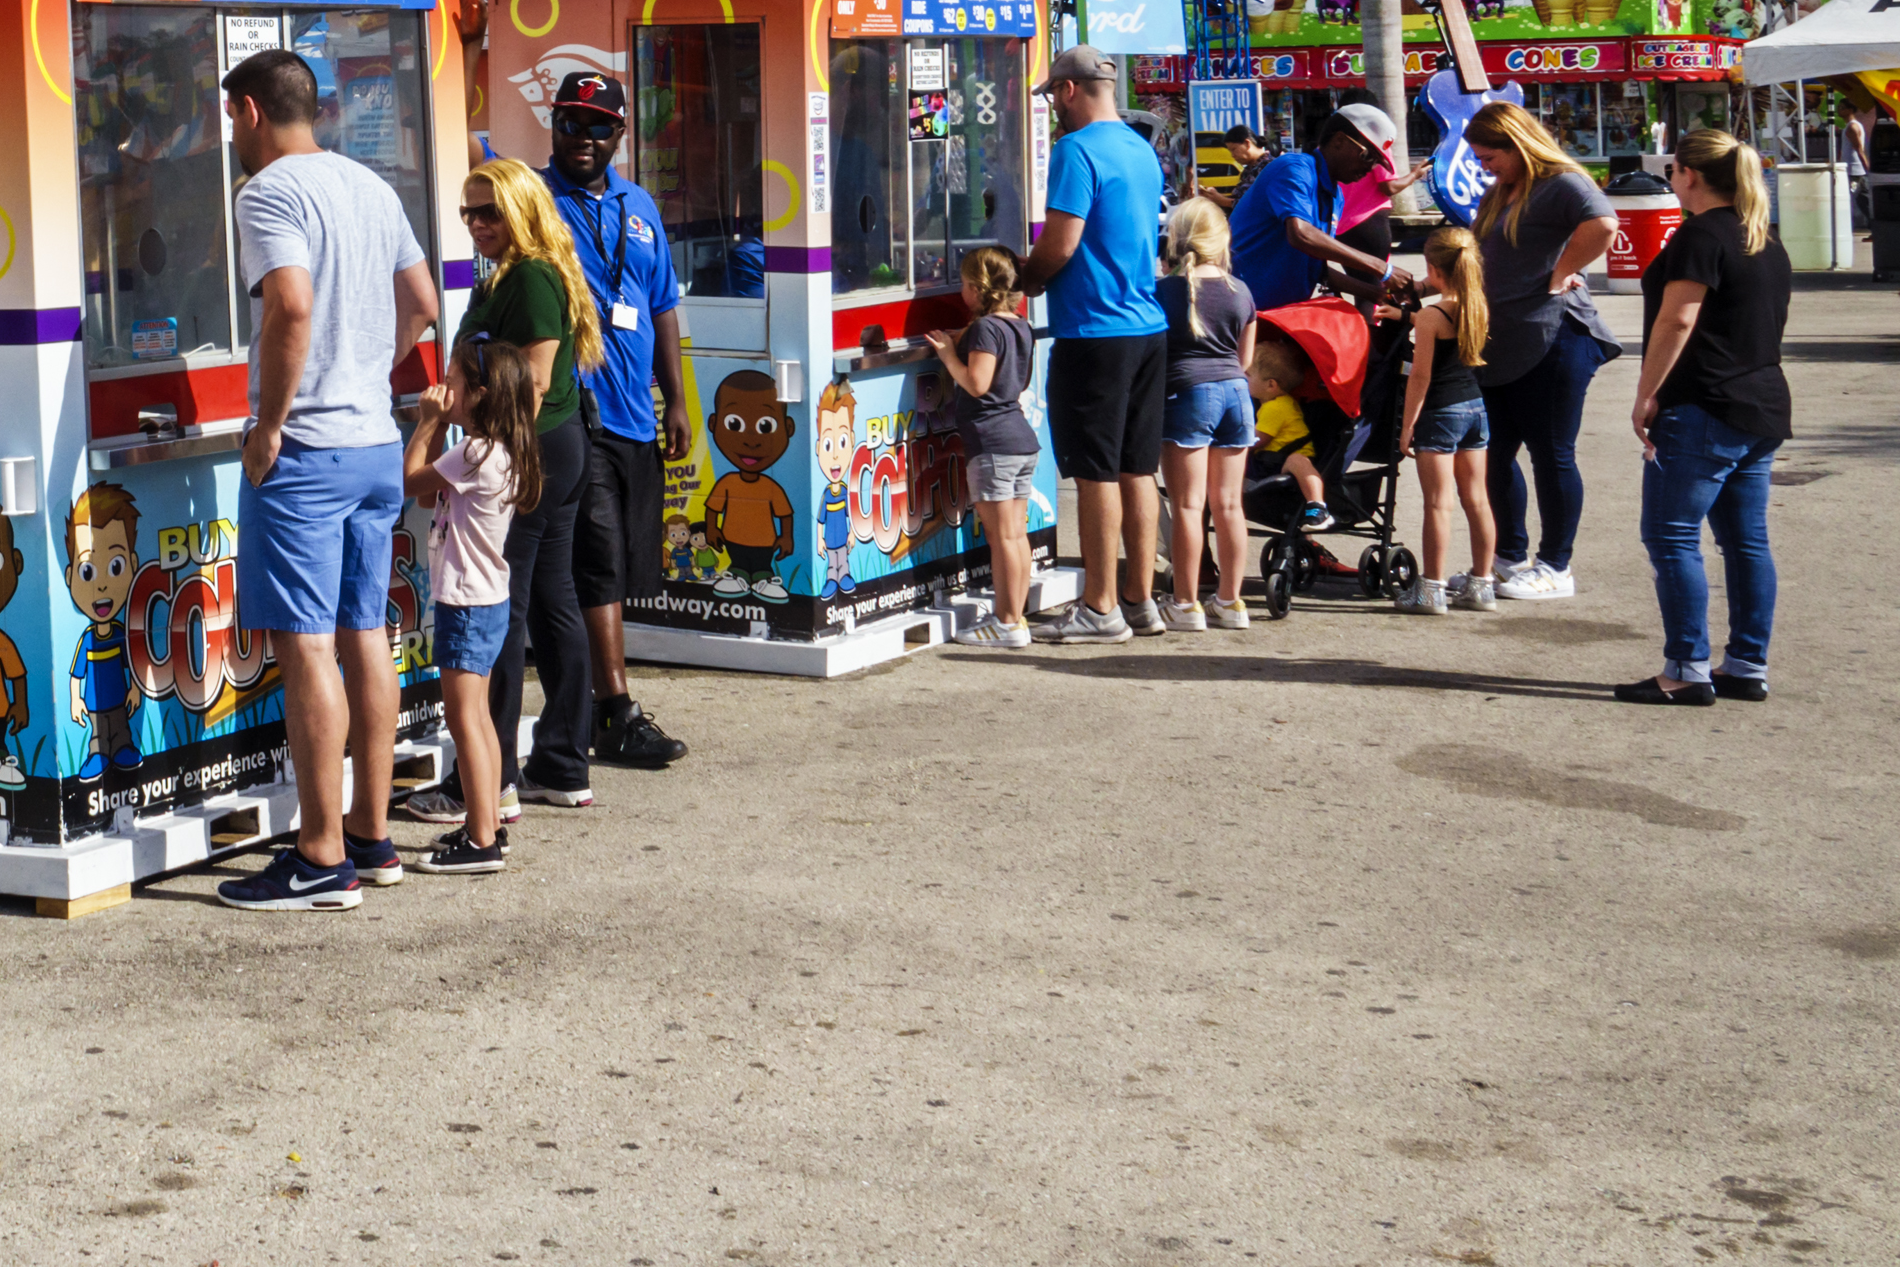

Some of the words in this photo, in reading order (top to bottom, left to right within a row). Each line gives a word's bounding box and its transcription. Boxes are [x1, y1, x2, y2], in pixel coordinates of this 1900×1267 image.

[1505, 46, 1600, 72] CONES
[1200, 88, 1236, 109] ENTER
[1237, 88, 1249, 108] TO
